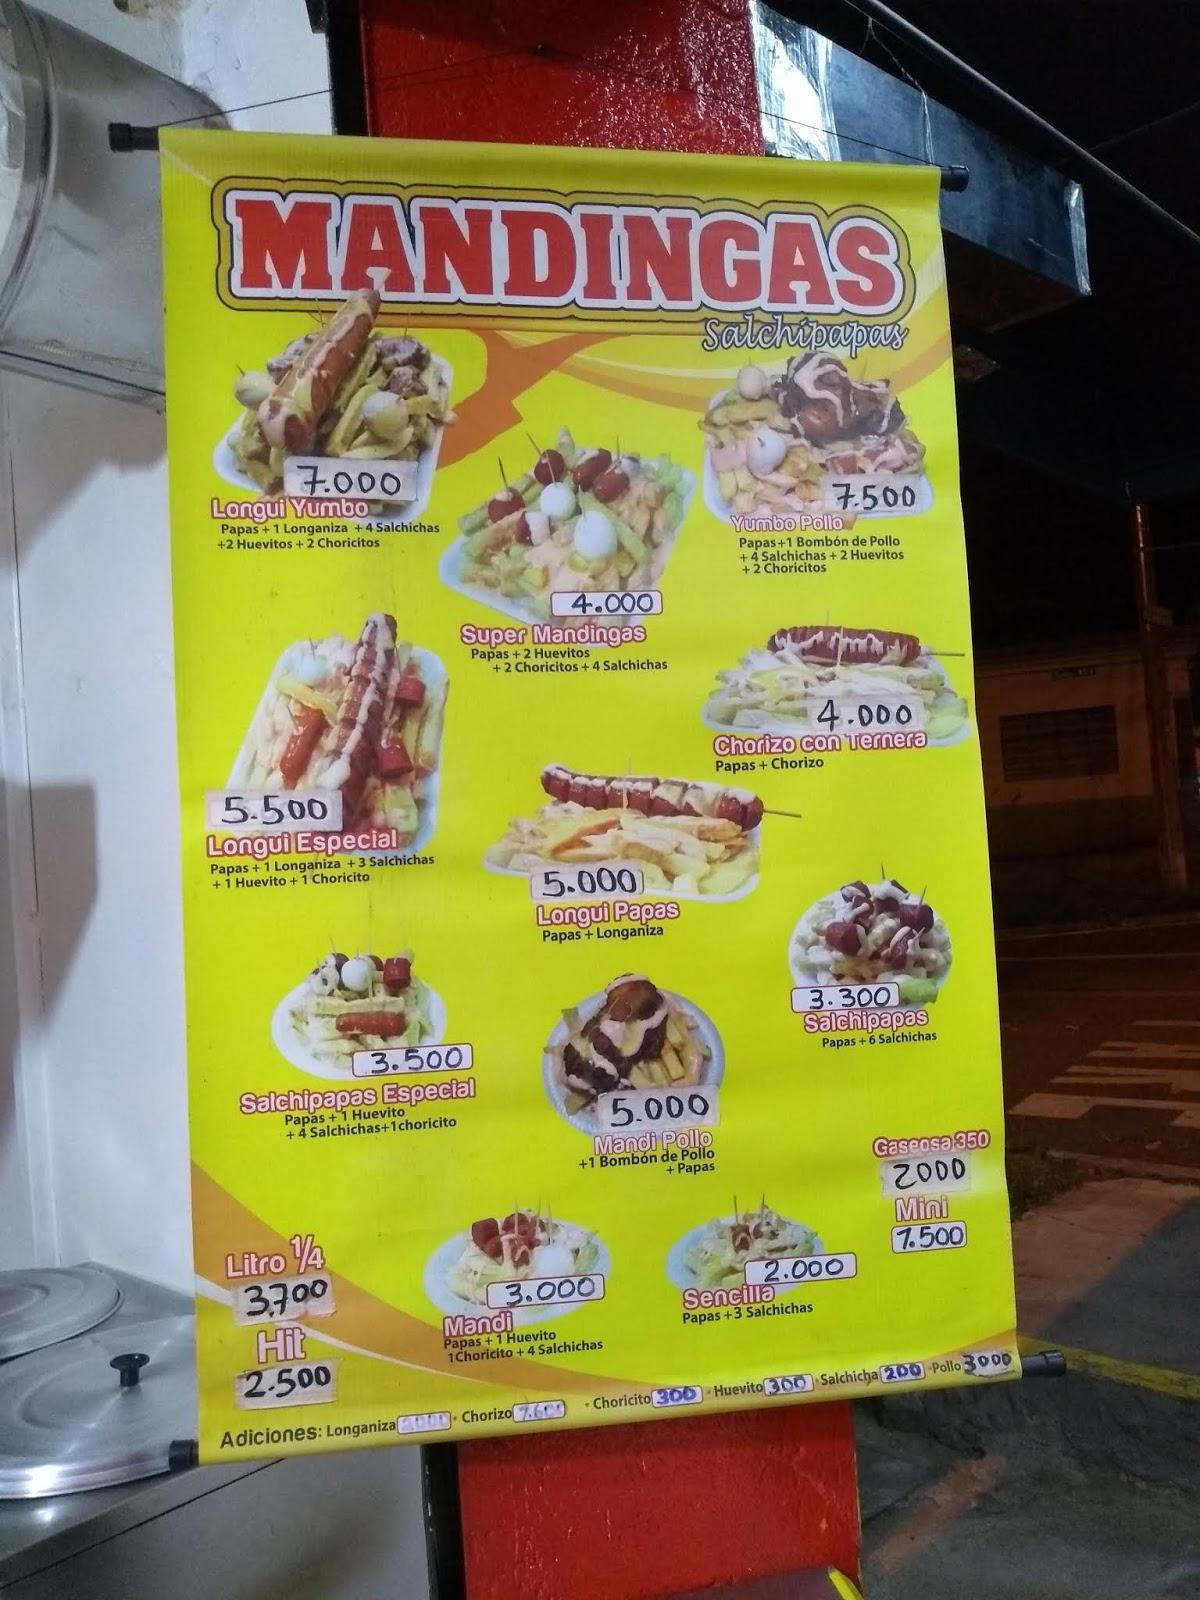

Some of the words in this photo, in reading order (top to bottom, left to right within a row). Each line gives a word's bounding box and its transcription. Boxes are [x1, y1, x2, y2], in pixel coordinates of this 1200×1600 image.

[232, 196, 897, 310] MANDINGAS
[297, 465, 401, 495] 7.000
[832, 483, 916, 510] 7.500
[211, 498, 285, 523] Longui
[288, 498, 369, 518] Yumbo
[221, 524, 259, 535] Papas
[284, 523, 348, 535] Longaniza
[376, 522, 440, 533] Salchichas
[730, 514, 795, 532] Yumbo
[800, 514, 844, 531] Pollo
[237, 538, 293, 549] Huevitos
[317, 538, 380, 548] Choricitos
[796, 536, 848, 547] Bombón
[852, 536, 866, 547] de
[870, 536, 900, 546] Pollo
[761, 551, 826, 561] Salchichas
[851, 549, 904, 560] Huevitos
[764, 563, 826, 574] Choricitos
[571, 593, 654, 614] 4.000
[460, 624, 526, 648] Super
[532, 624, 647, 648] Mandingas
[471, 649, 509, 661] Papas
[534, 647, 590, 658] Huevitos
[515, 661, 578, 672] Choricitos
[603, 659, 668, 671] Salchichas
[817, 699, 912, 732] 4.000
[713, 735, 796, 756] Chorizo
[800, 735, 841, 752] con
[847, 731, 928, 751] Ternera
[716, 760, 756, 774] Papas
[771, 757, 824, 770] Chorizo
[222, 795, 328, 825] 5.500
[206, 833, 291, 860] Longui
[295, 828, 398, 855] Especial
[211, 863, 249, 876] Papas
[274, 859, 341, 872] Longaniza
[369, 854, 434, 867] Salchichas
[235, 876, 287, 888] Huevito
[312, 872, 370, 884] Choricito
[543, 867, 637, 897] 5.000
[536, 901, 610, 928] Longui
[614, 900, 680, 924] Papas
[543, 930, 581, 943] Papas
[597, 924, 664, 940] Longaniza
[809, 987, 891, 1010] 3.300
[804, 1010, 929, 1033] Salchipapas
[822, 1037, 856, 1049] Papas
[879, 1031, 937, 1045] Salchichas
[371, 1047, 463, 1074] 3.500
[240, 1086, 377, 1114] Salchipapas
[382, 1077, 476, 1106] Especial
[285, 1113, 325, 1127] Papas
[352, 1108, 406, 1121] Huevito
[611, 1094, 710, 1127] 5.000
[594, 1132, 657, 1156] Mandi
[662, 1129, 713, 1150] Pollo
[873, 1136, 951, 1157] Gaseosa
[954, 1129, 991, 1150] 350
[600, 1152, 657, 1167] Bombón
[661, 1151, 678, 1162] de
[681, 1148, 715, 1160] Pollo
[678, 1162, 715, 1175] Papas
[893, 1158, 966, 1190] 2000
[895, 1195, 948, 1222] Mini
[226, 1252, 286, 1279] Litro
[764, 1259, 844, 1282] 2.000
[505, 1277, 595, 1306] 3.000
[683, 1284, 775, 1309] Sencilla
[443, 1310, 513, 1338] Mandi
[683, 1311, 721, 1325] Papas
[747, 1303, 813, 1318] Salchichas
[256, 1327, 306, 1364] Hit
[444, 1337, 482, 1349] Papas
[507, 1330, 556, 1343] Huevito
[539, 1340, 603, 1355] Salchichas
[244, 1366, 331, 1398] 2.500
[221, 1425, 322, 1448] Adiciones:
[326, 1420, 396, 1437] Longaniza
[462, 1408, 512, 1422] Chorizo
[593, 1392, 651, 1410] Choricito
[656, 1386, 696, 1405] 300
[714, 1381, 763, 1397] Huevito
[769, 1376, 807, 1395] 300
[820, 1370, 879, 1386] Salchicha
[884, 1363, 921, 1380] 200
[932, 1360, 961, 1375] Pollo
[964, 1353, 1012, 1372] 3000
